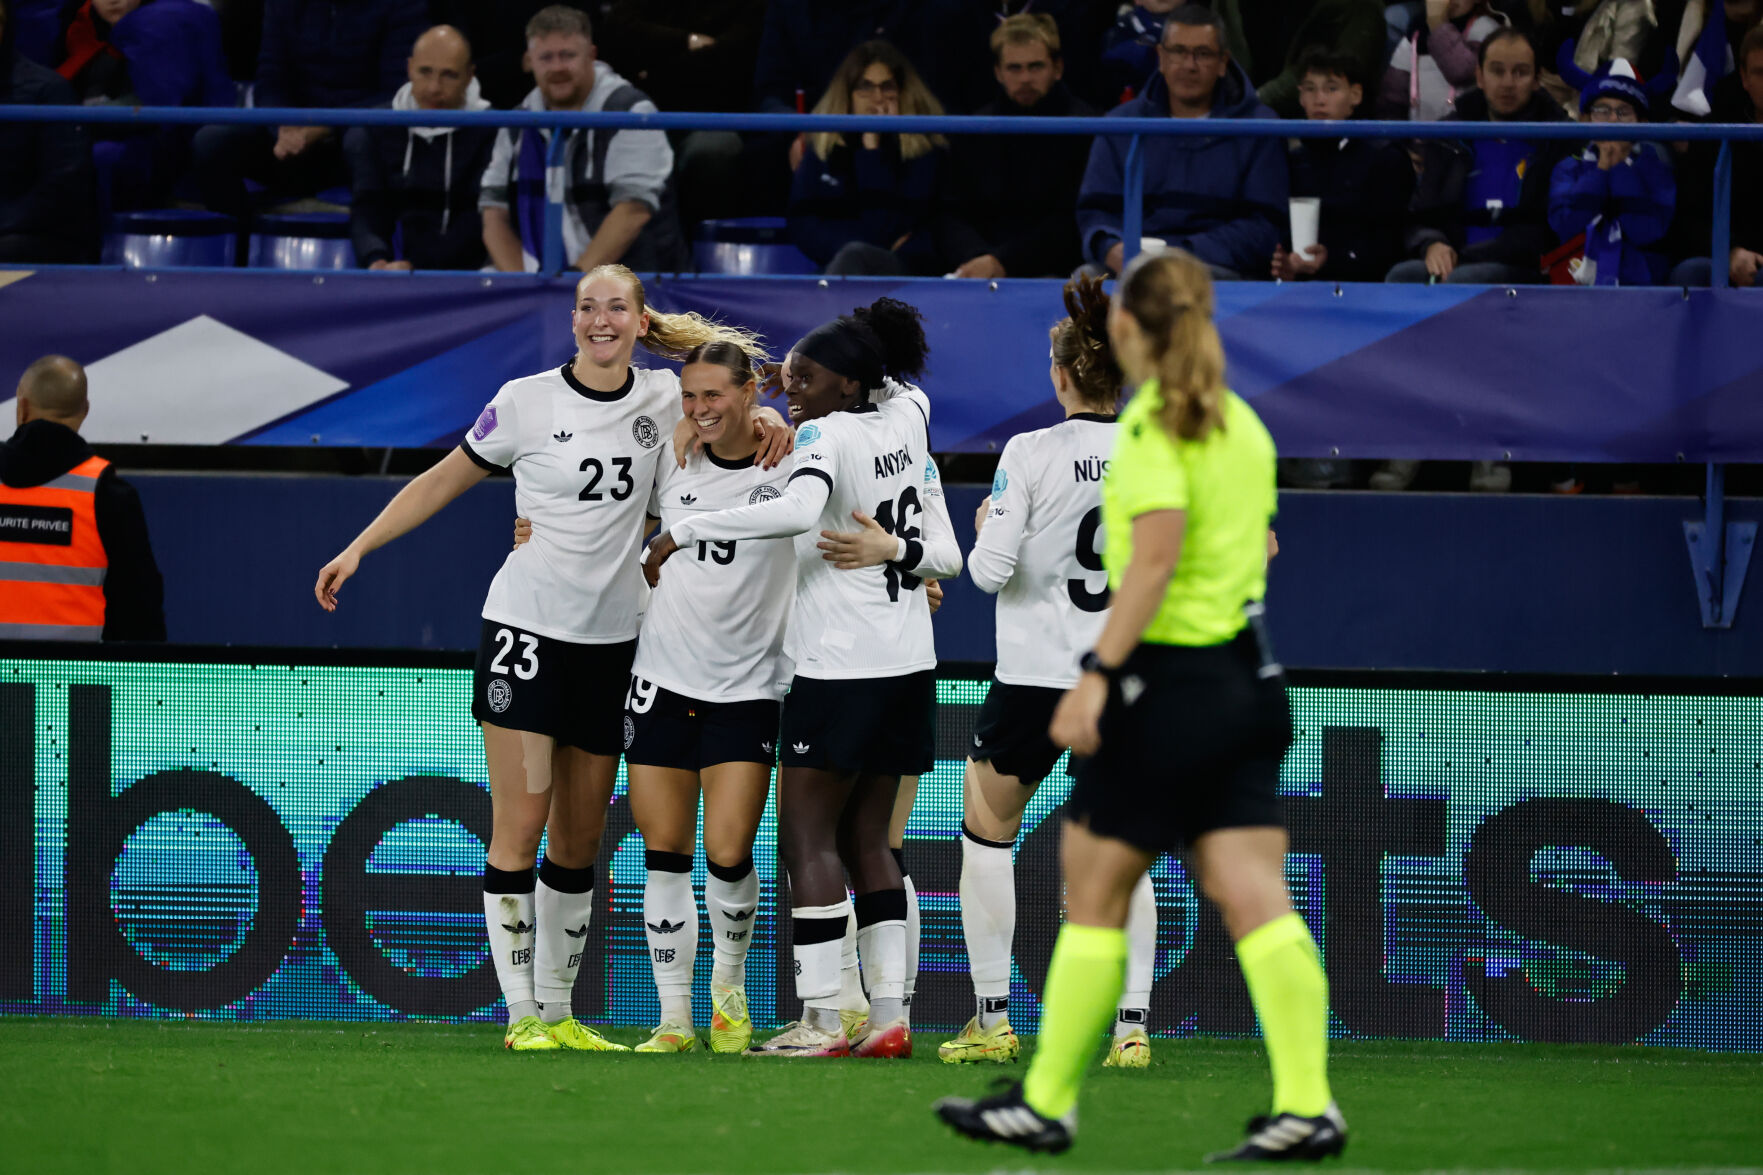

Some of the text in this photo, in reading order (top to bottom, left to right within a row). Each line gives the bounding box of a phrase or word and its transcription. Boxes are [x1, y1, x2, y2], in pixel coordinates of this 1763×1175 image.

[578, 457, 635, 502] 23
[1067, 505, 1113, 613] 9
[489, 628, 540, 681] 23
[624, 674, 659, 715] 19
[0, 683, 695, 1019] be
